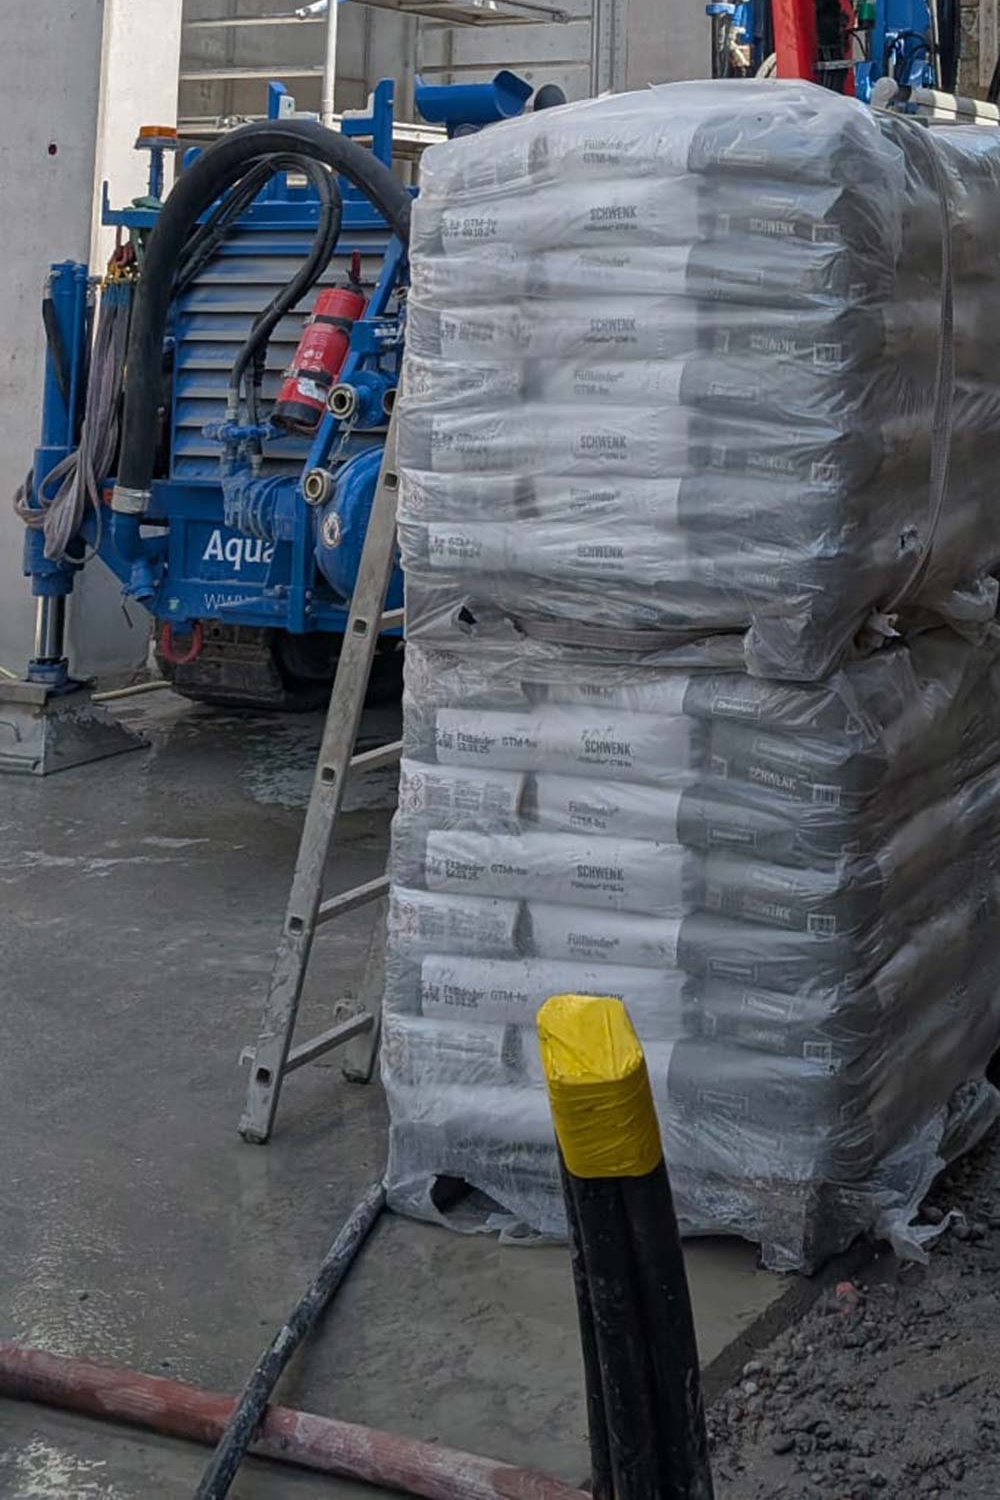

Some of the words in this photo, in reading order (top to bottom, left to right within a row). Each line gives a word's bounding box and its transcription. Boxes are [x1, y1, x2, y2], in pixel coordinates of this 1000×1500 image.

[589, 205, 638, 221] SCHWENK
[590, 318, 637, 333] SCHWENK
[579, 435, 627, 449] SCHWENK
[202, 529, 274, 570] Aqua
[584, 741, 632, 756] SCHWENK
[576, 864, 625, 881] SCHWENK
